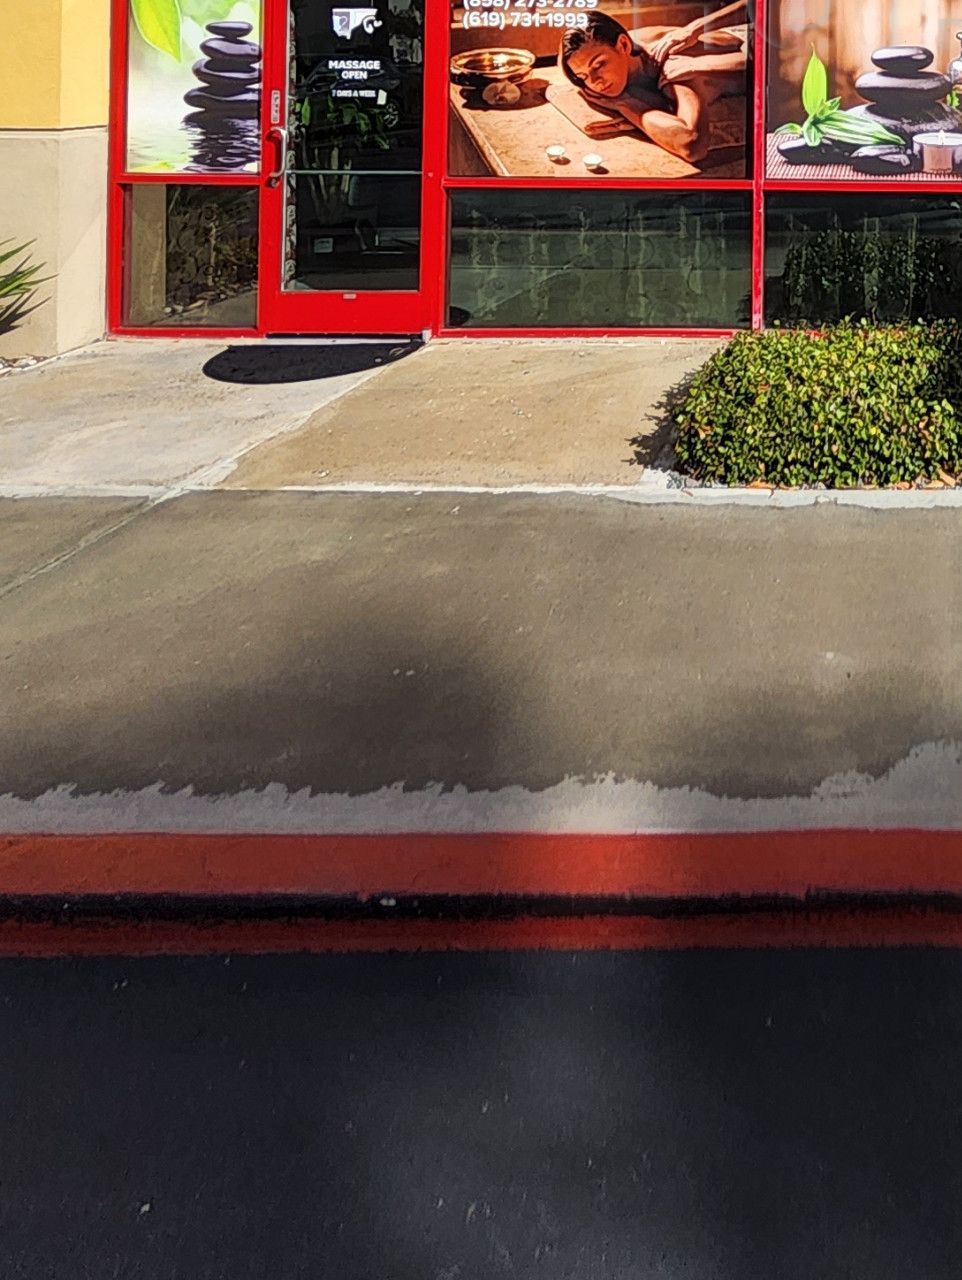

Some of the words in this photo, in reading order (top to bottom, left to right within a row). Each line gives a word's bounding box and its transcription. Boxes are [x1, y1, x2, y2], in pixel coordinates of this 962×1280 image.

[463, 11, 505, 30] (619)
[510, 12, 588, 28] 731-1999
[328, 60, 381, 70] MASSAGE
[341, 70, 368, 80] OPEN
